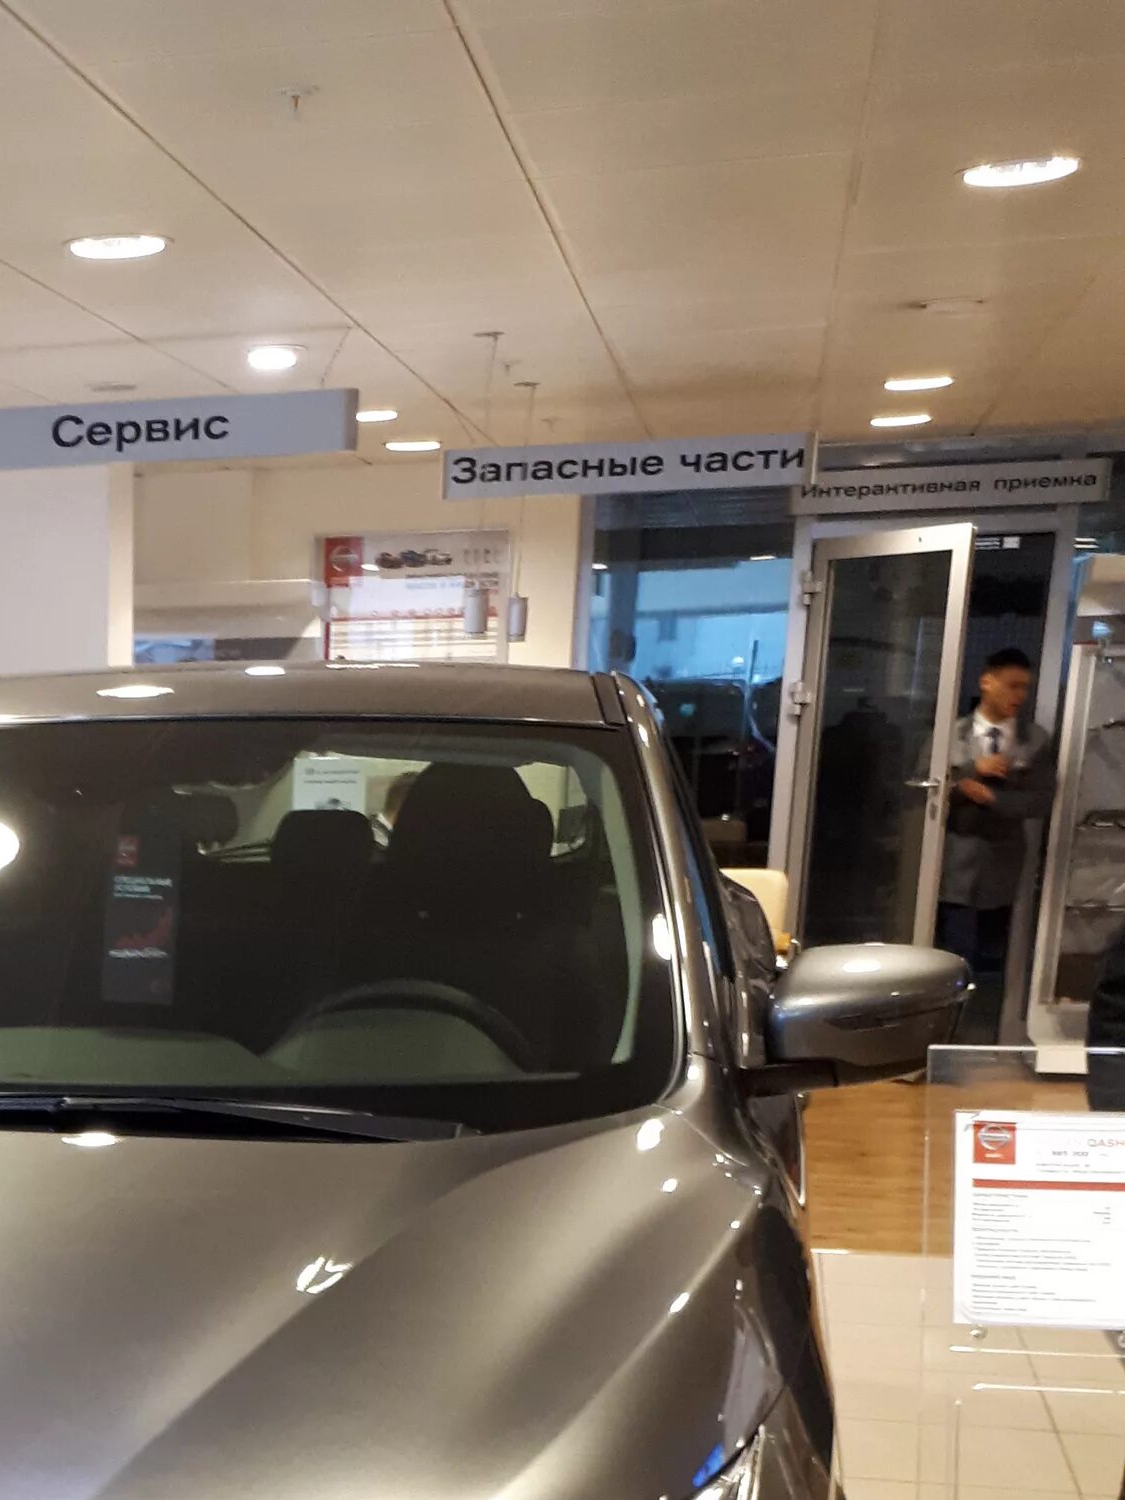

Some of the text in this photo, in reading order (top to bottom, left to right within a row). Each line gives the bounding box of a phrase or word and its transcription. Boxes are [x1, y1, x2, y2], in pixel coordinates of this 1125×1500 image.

[51, 414, 230, 452] Сервис
[451, 448, 805, 484] Запасные части
